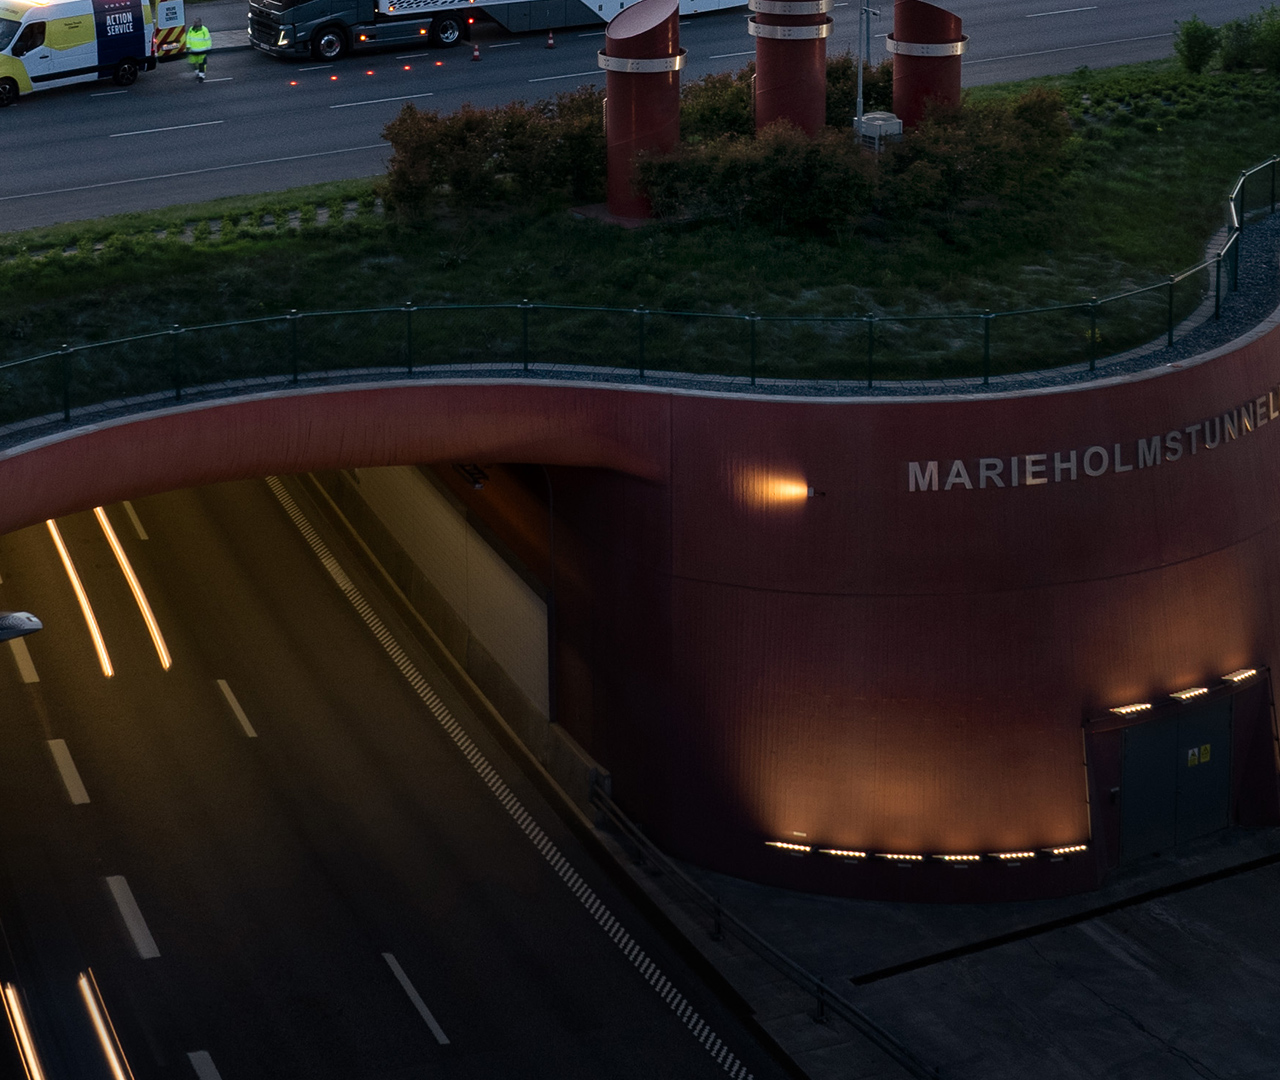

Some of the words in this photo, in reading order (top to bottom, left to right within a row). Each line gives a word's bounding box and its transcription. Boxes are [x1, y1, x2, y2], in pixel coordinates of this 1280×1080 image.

[104, 1, 131, 9] VOLVO
[106, 12, 133, 26] ACTION
[107, 22, 134, 36] SERVICE
